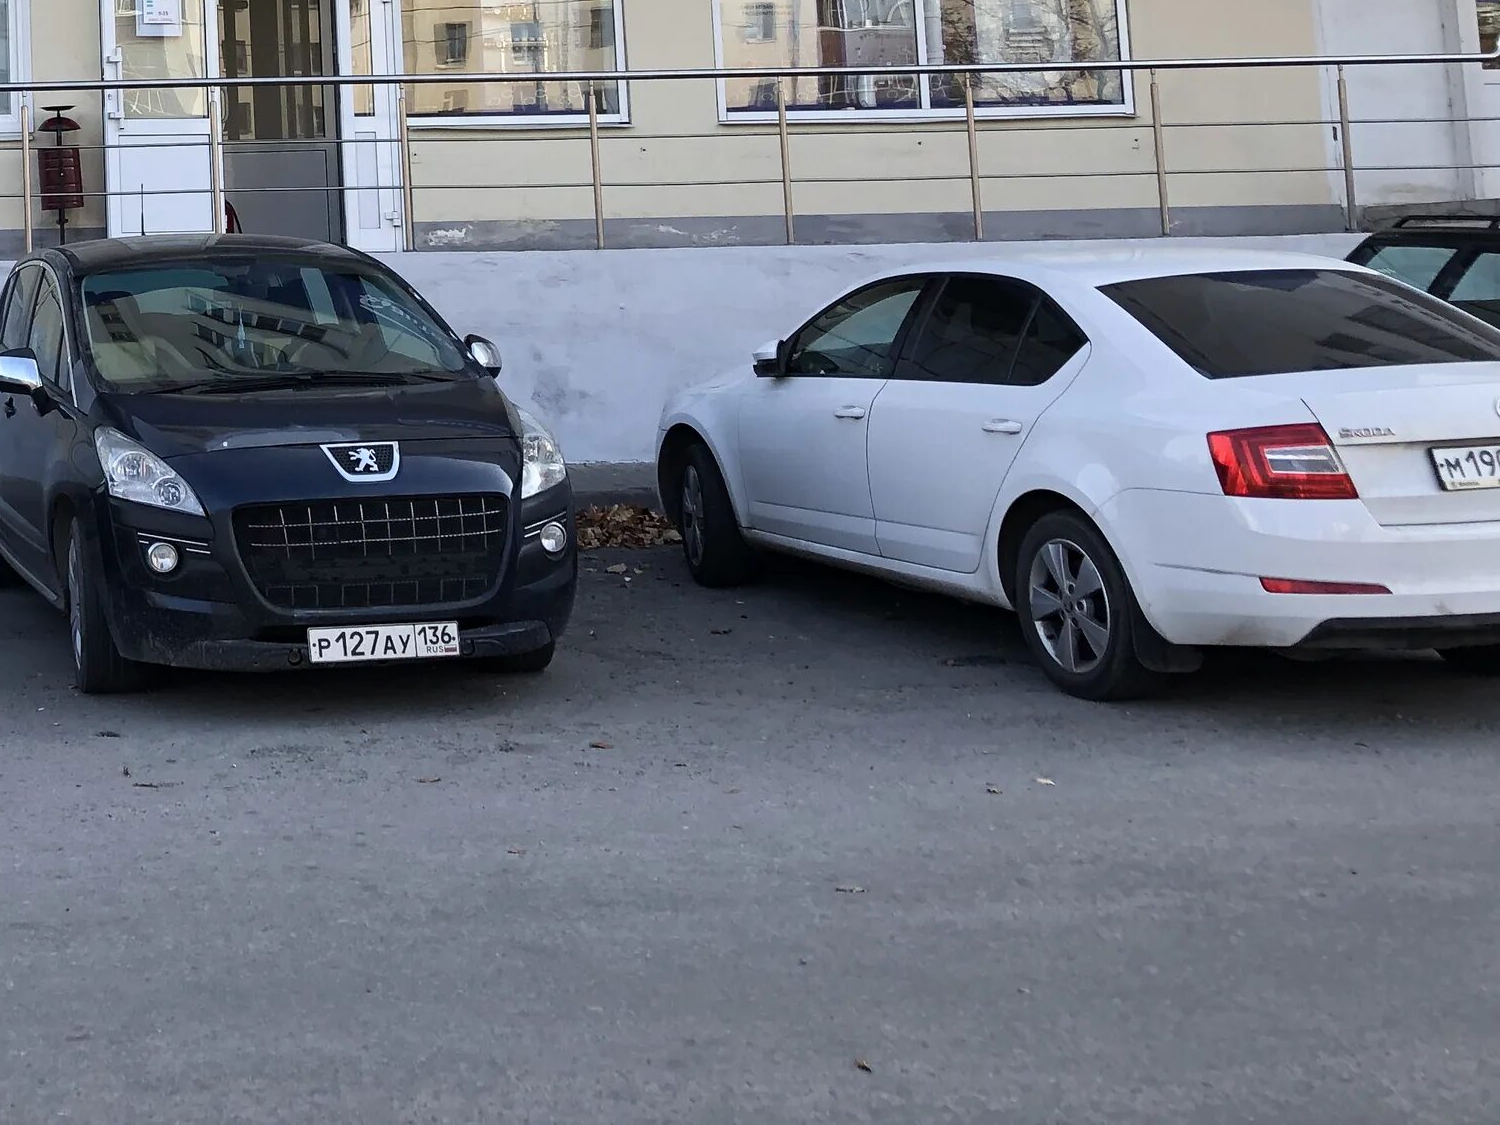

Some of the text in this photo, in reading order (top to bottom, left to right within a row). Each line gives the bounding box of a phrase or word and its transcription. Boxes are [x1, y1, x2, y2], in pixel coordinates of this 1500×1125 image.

[1444, 449, 1500, 479] М19
[417, 625, 452, 646] 136
[426, 645, 444, 654] RUS
